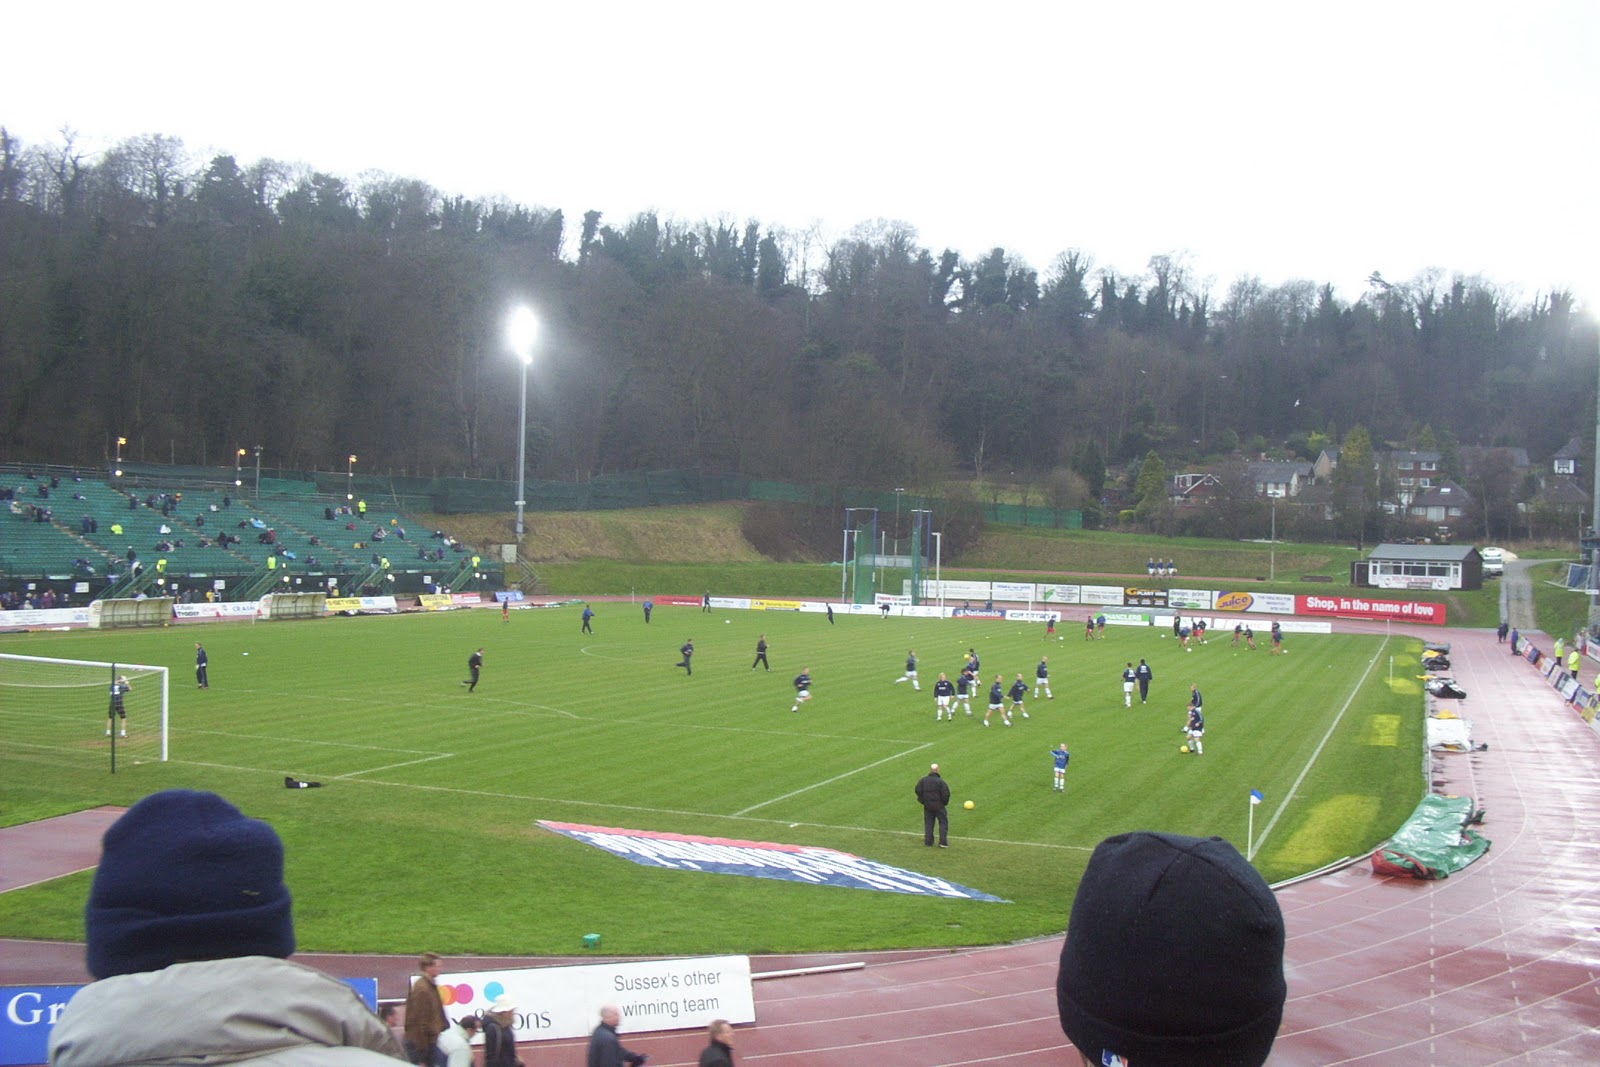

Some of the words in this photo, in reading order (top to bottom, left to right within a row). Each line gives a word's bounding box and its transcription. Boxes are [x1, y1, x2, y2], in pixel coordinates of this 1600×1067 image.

[964, 609, 1002, 618] Nationwide
[1307, 597, 1338, 611] Shop,
[1341, 599, 1351, 610] in
[1353, 600, 1370, 611] the
[1372, 602, 1401, 613] name
[1402, 603, 1413, 614] of
[1414, 603, 1434, 616] love
[614, 972, 680, 992] Sussex's
[684, 970, 721, 987] other
[7, 991, 66, 1026] Gr
[622, 996, 679, 1018] winning
[683, 997, 720, 1013] team
[511, 1010, 551, 1031] ons
